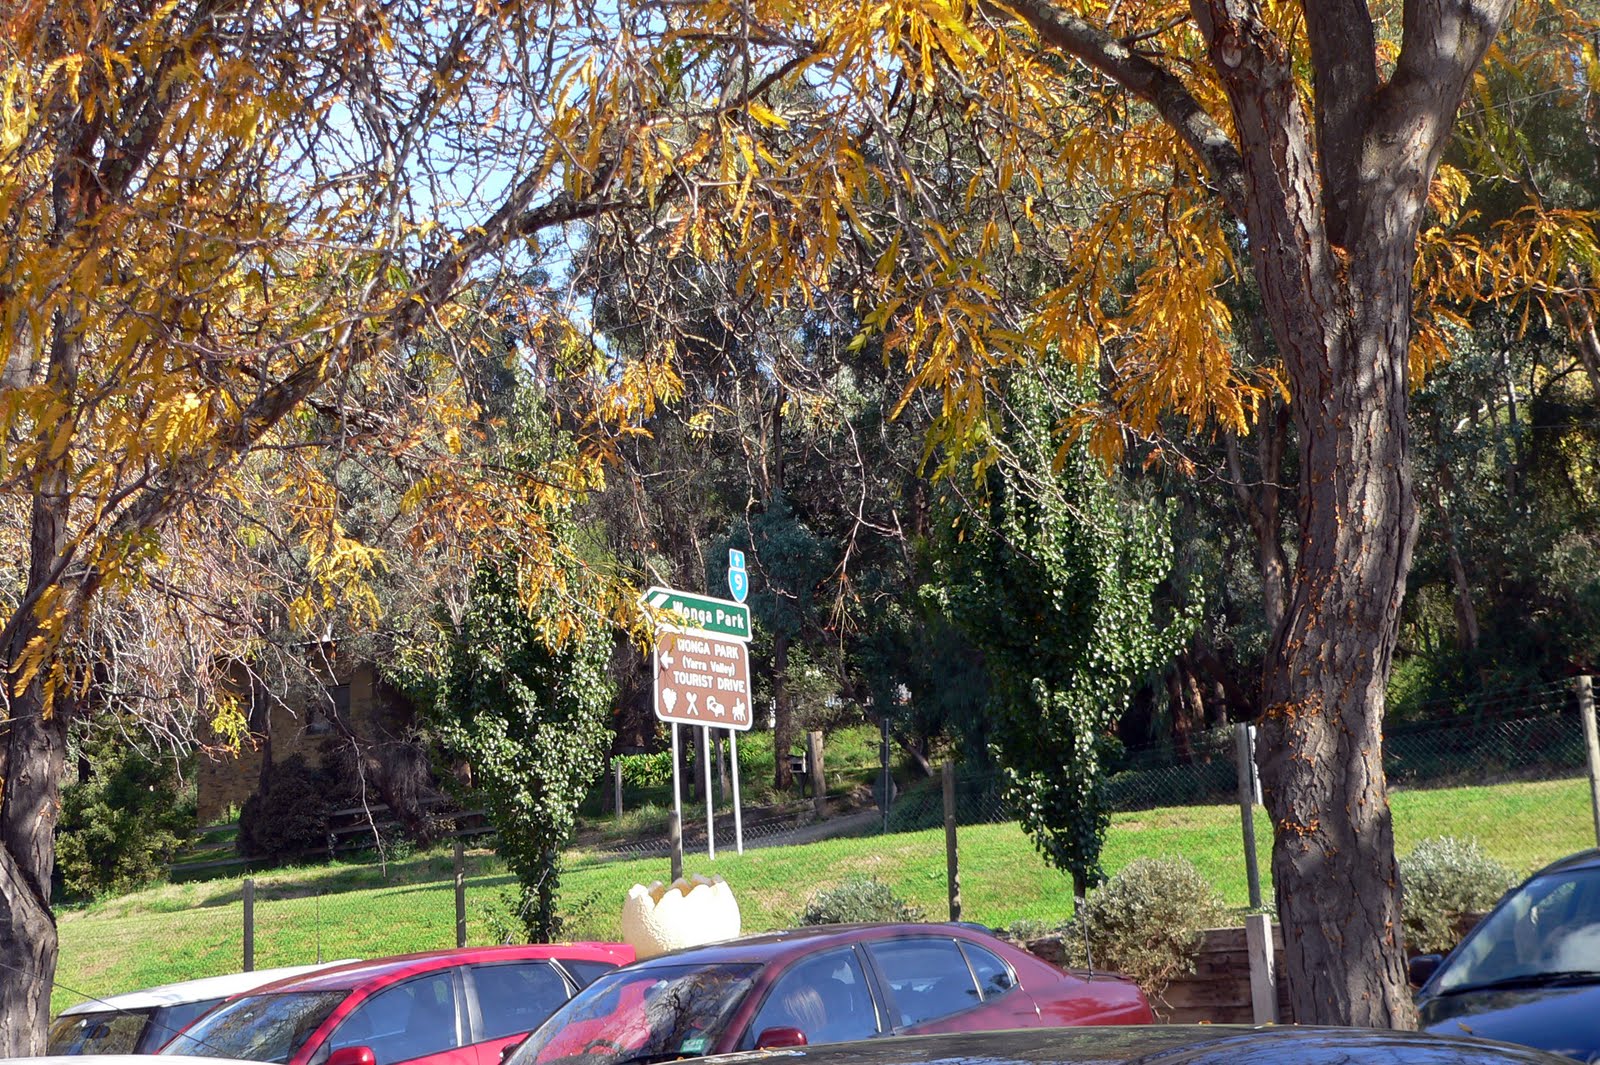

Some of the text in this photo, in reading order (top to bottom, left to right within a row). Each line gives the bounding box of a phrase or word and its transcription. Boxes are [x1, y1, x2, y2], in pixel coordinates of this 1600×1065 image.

[734, 574, 743, 591] 9
[672, 601, 745, 630] Wonga Park
[677, 638, 739, 660] WONGA PARK
[682, 655, 735, 677] (Yarra Valley)
[673, 671, 745, 693] TOURIST DRIVE
